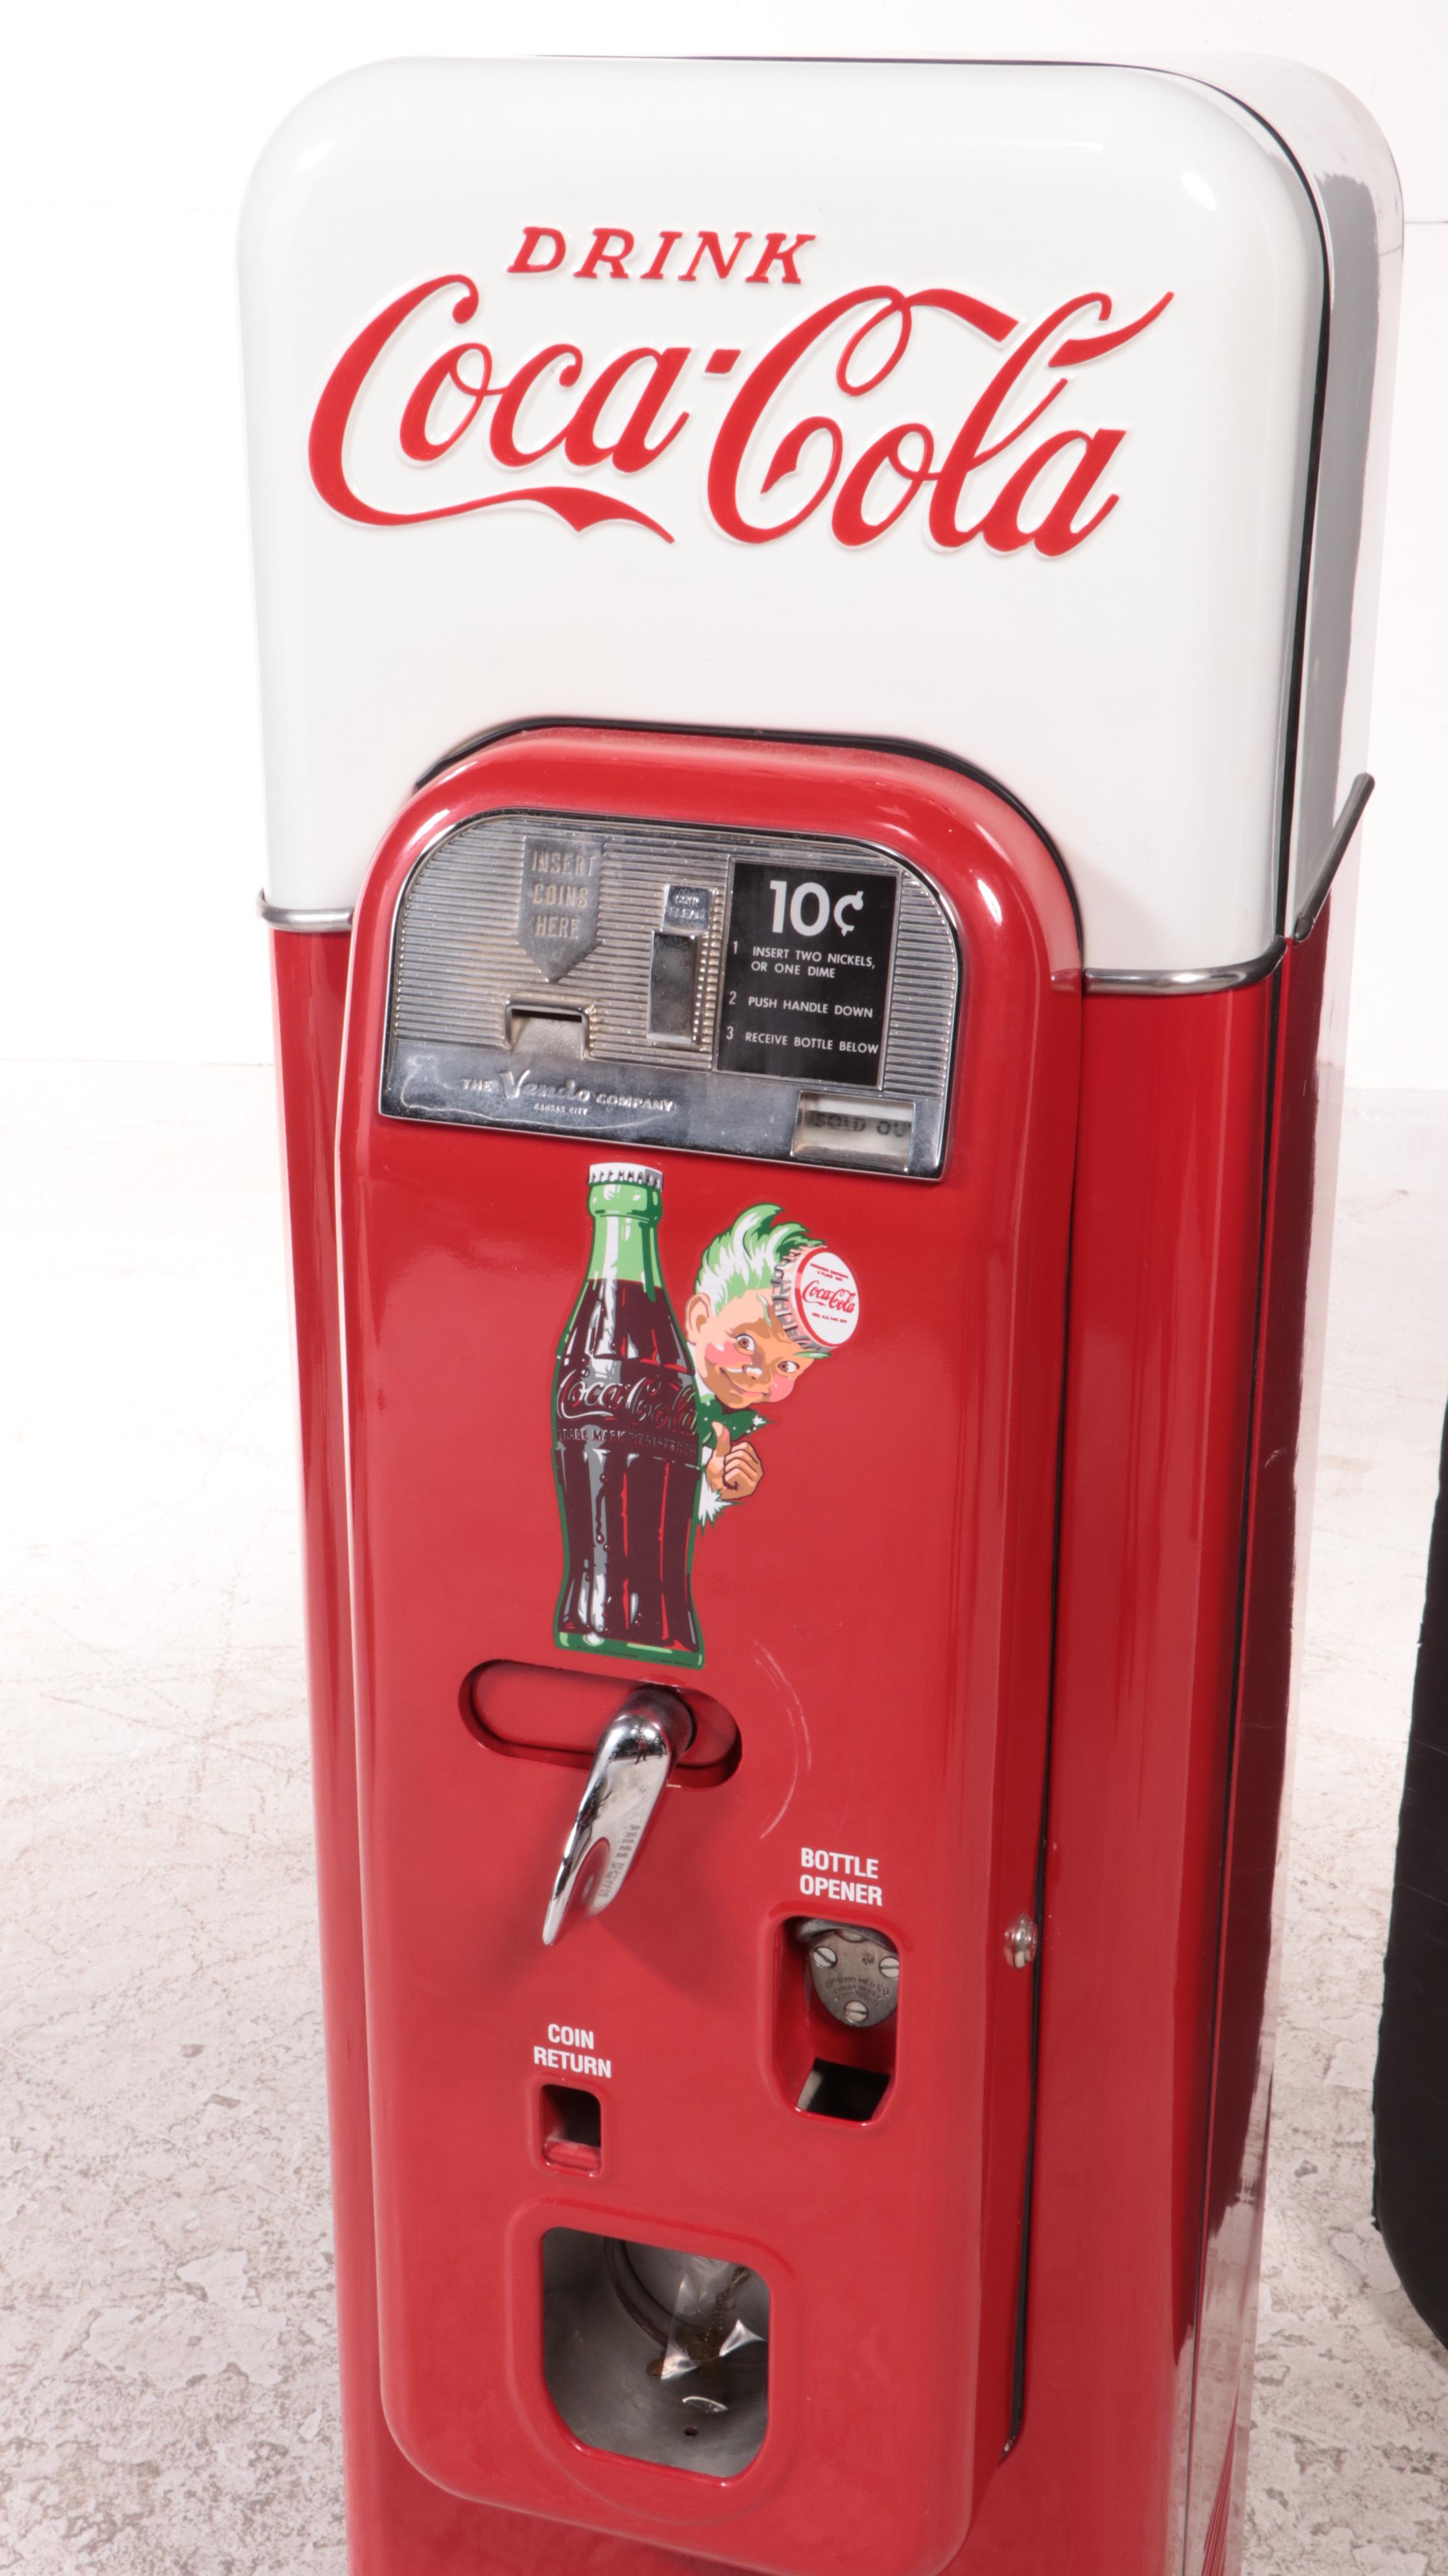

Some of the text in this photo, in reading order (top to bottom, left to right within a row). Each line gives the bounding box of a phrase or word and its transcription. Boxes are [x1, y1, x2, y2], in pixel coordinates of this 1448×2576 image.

[507, 226, 816, 284] DRINK
[308, 273, 1175, 557] Coca-Cola
[531, 850, 598, 877] INSERT
[533, 882, 588, 909] COINS
[770, 880, 864, 936] 10¢
[534, 914, 580, 939] HERE
[733, 941, 875, 970] 1 INSERT TWO NICKELS,
[751, 961, 835, 978] OR ONE DIME
[729, 991, 873, 1018] 2 PUSH HANDLE DOWN
[726, 1025, 878, 1054] 3 RECEIVE BOTTLE BELOW
[462, 1069, 674, 1112] THE Vendo COMPANY
[801, 1848, 878, 1878] BOTTLE
[800, 1875, 882, 1906] OPENER
[548, 2024, 594, 2049] COIN
[533, 2046, 612, 2078] RETURN
